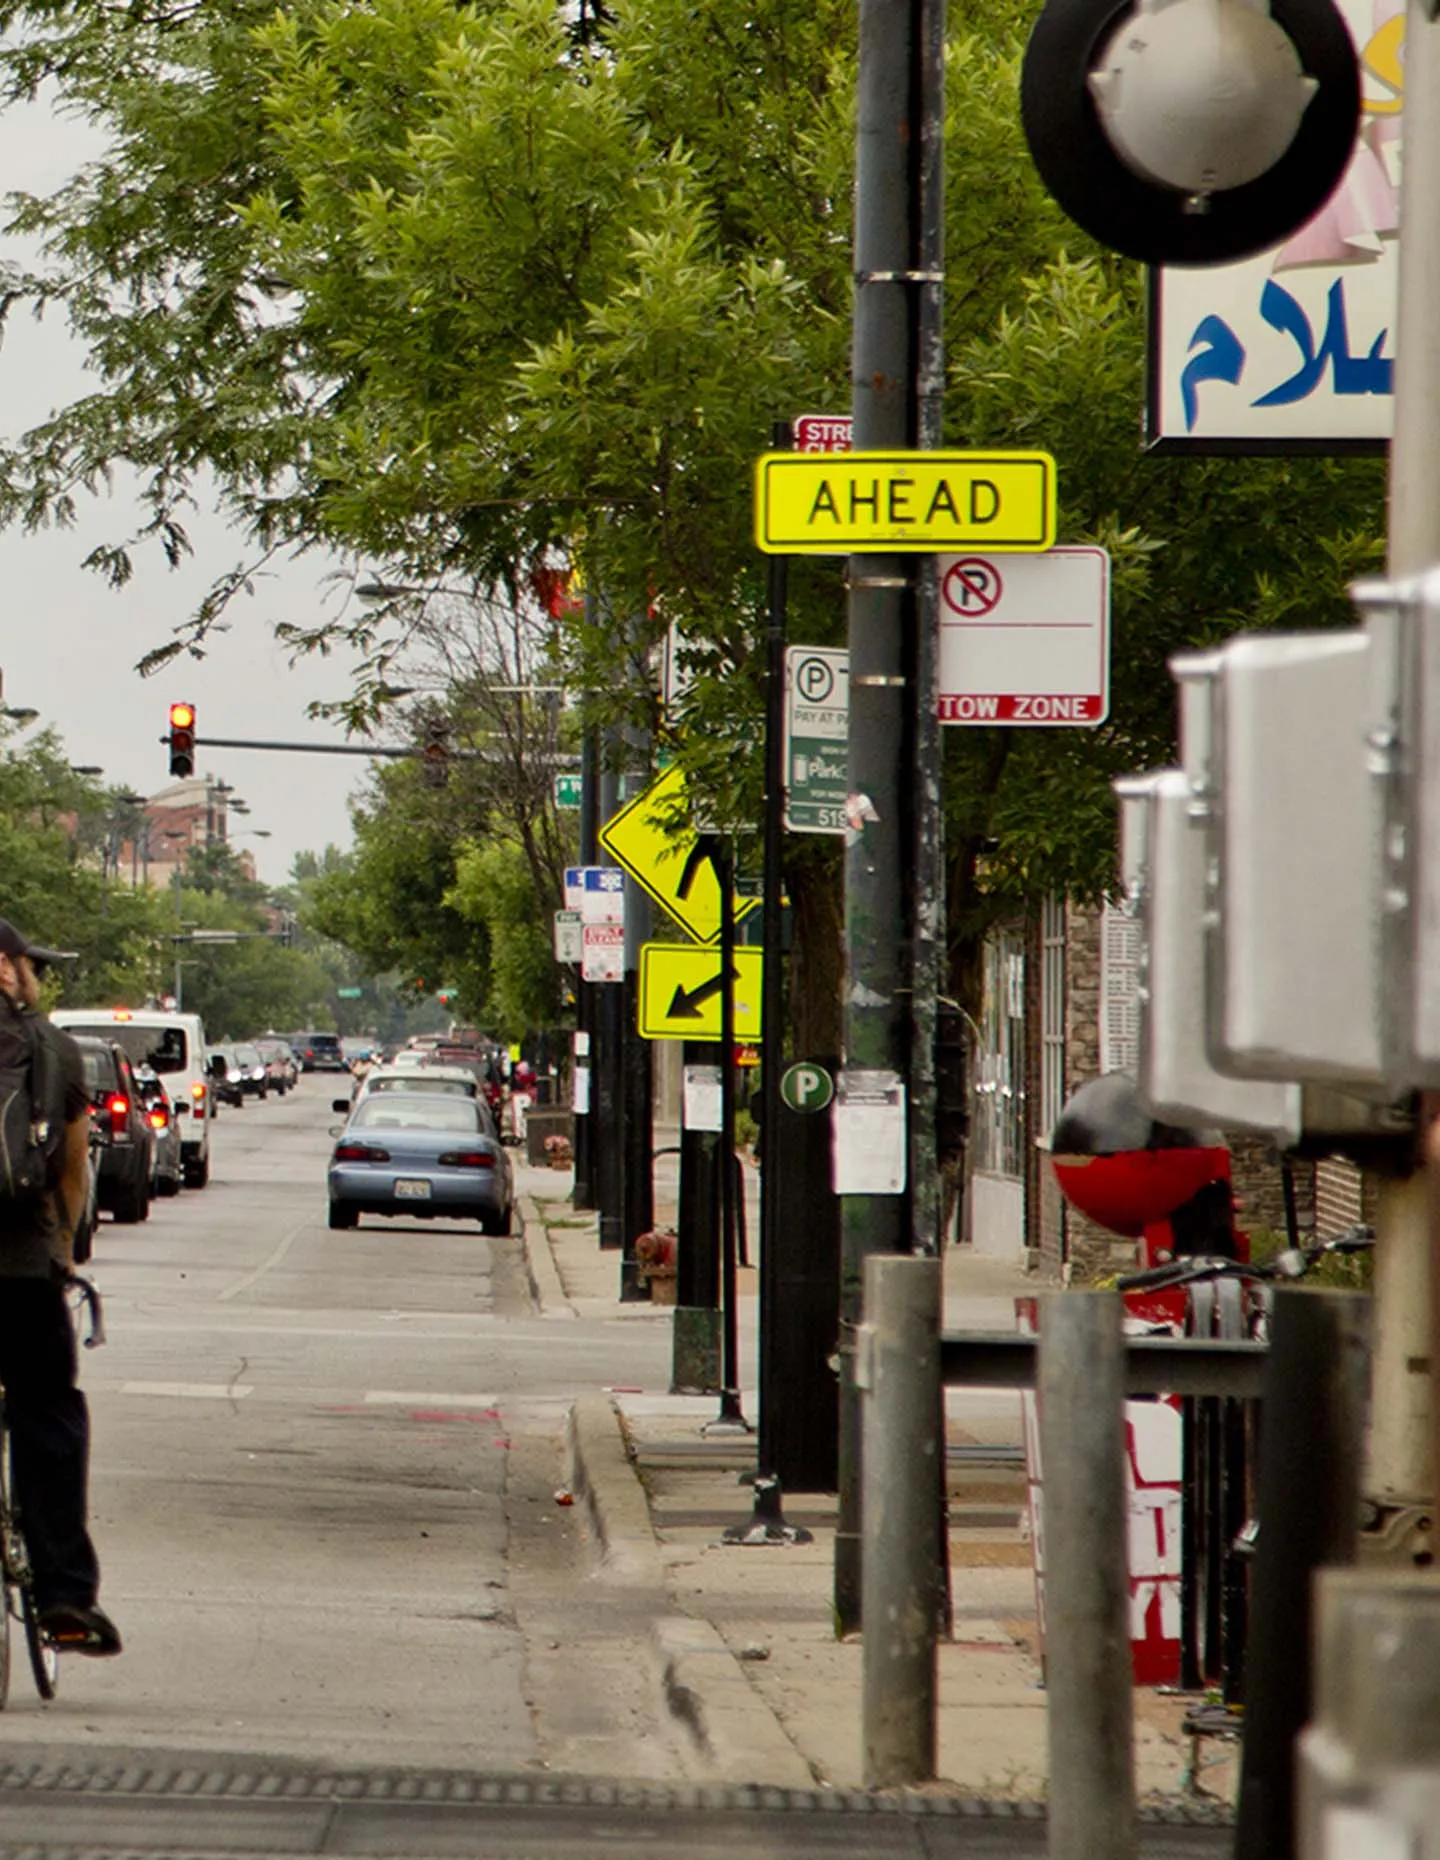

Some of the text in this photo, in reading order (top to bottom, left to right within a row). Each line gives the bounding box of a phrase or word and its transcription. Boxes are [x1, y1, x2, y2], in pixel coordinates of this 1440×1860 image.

[806, 423, 855, 441] STRE
[807, 479, 1001, 525] AHEAD
[794, 711, 815, 723] PAY
[940, 697, 1089, 719] TOW ZONE
[797, 1071, 819, 1105] P
